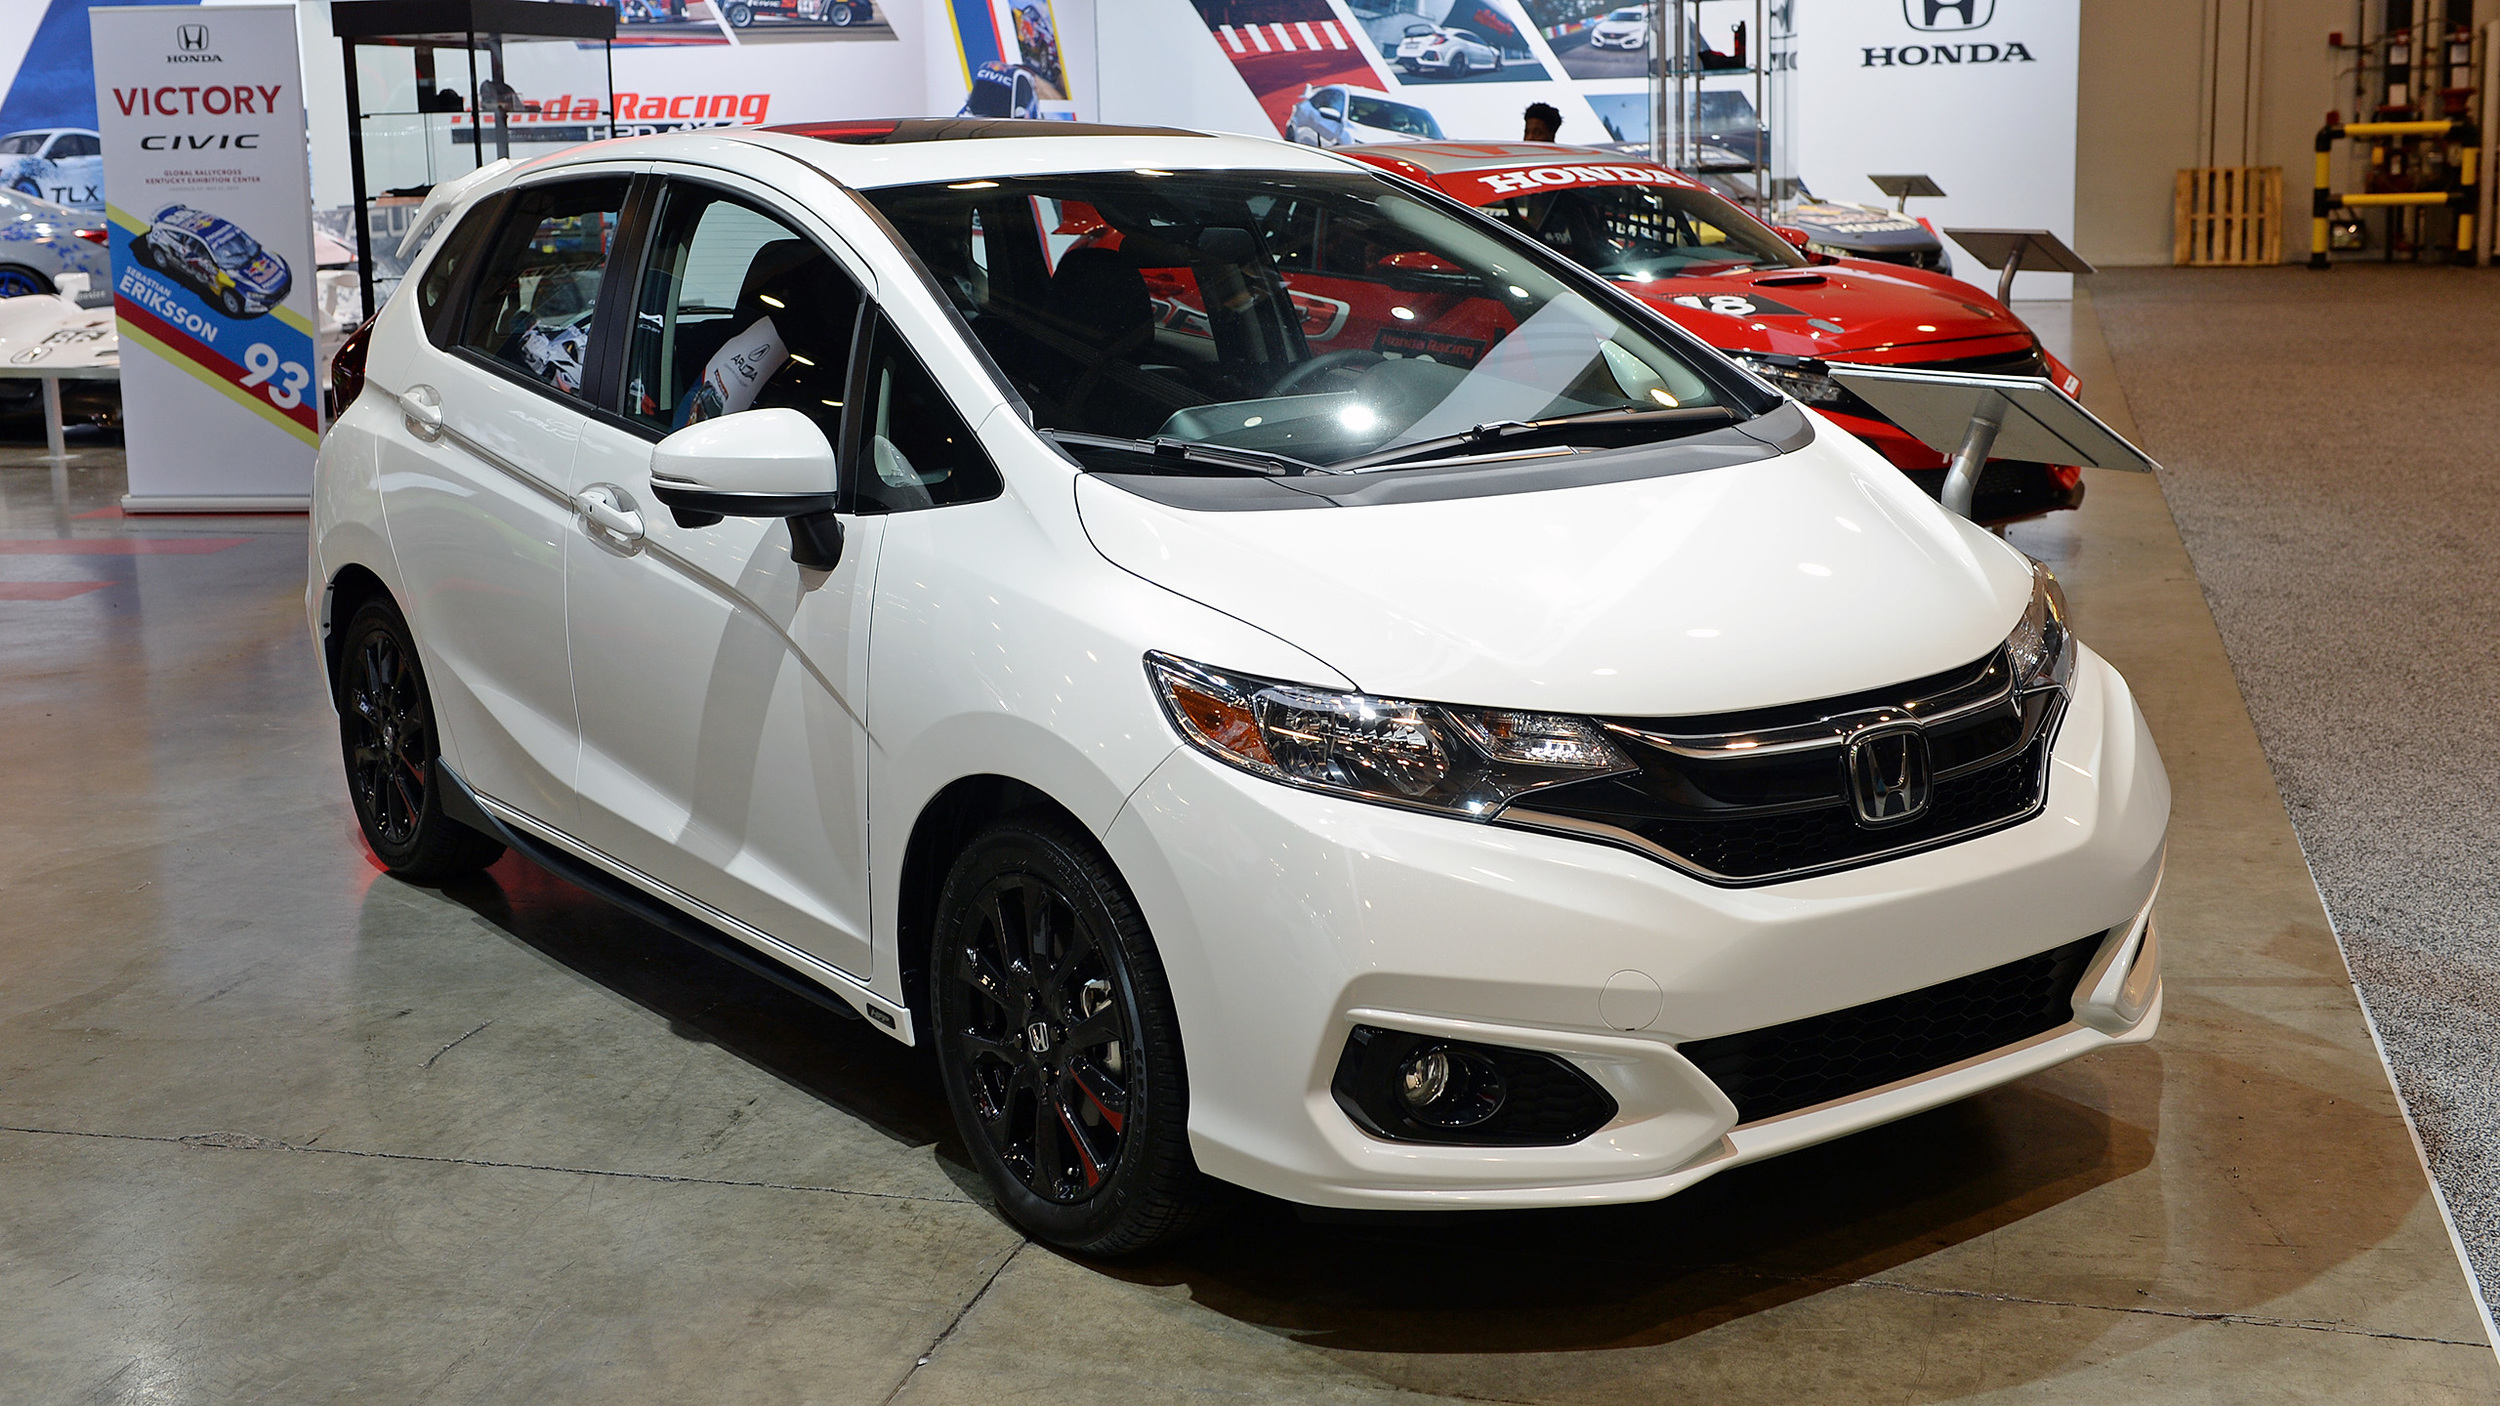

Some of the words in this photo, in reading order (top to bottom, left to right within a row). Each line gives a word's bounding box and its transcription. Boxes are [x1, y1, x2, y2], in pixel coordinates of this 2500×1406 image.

[166, 55, 223, 63] HONDA
[1860, 43, 2037, 67] HONDA
[977, 69, 1013, 87] CIVIC
[113, 85, 282, 116] VICTORY
[451, 94, 600, 124] nda
[613, 93, 771, 124] Racing
[141, 134, 260, 150] CIVIC
[1477, 166, 1696, 193] HONDA
[51, 185, 100, 203] TLX
[126, 265, 172, 297] SEBASTIAN
[119, 275, 218, 343] ERIKSSON
[1382, 334, 1425, 350] Honda
[1426, 339, 1476, 359] Racing
[239, 342, 310, 409] 93
